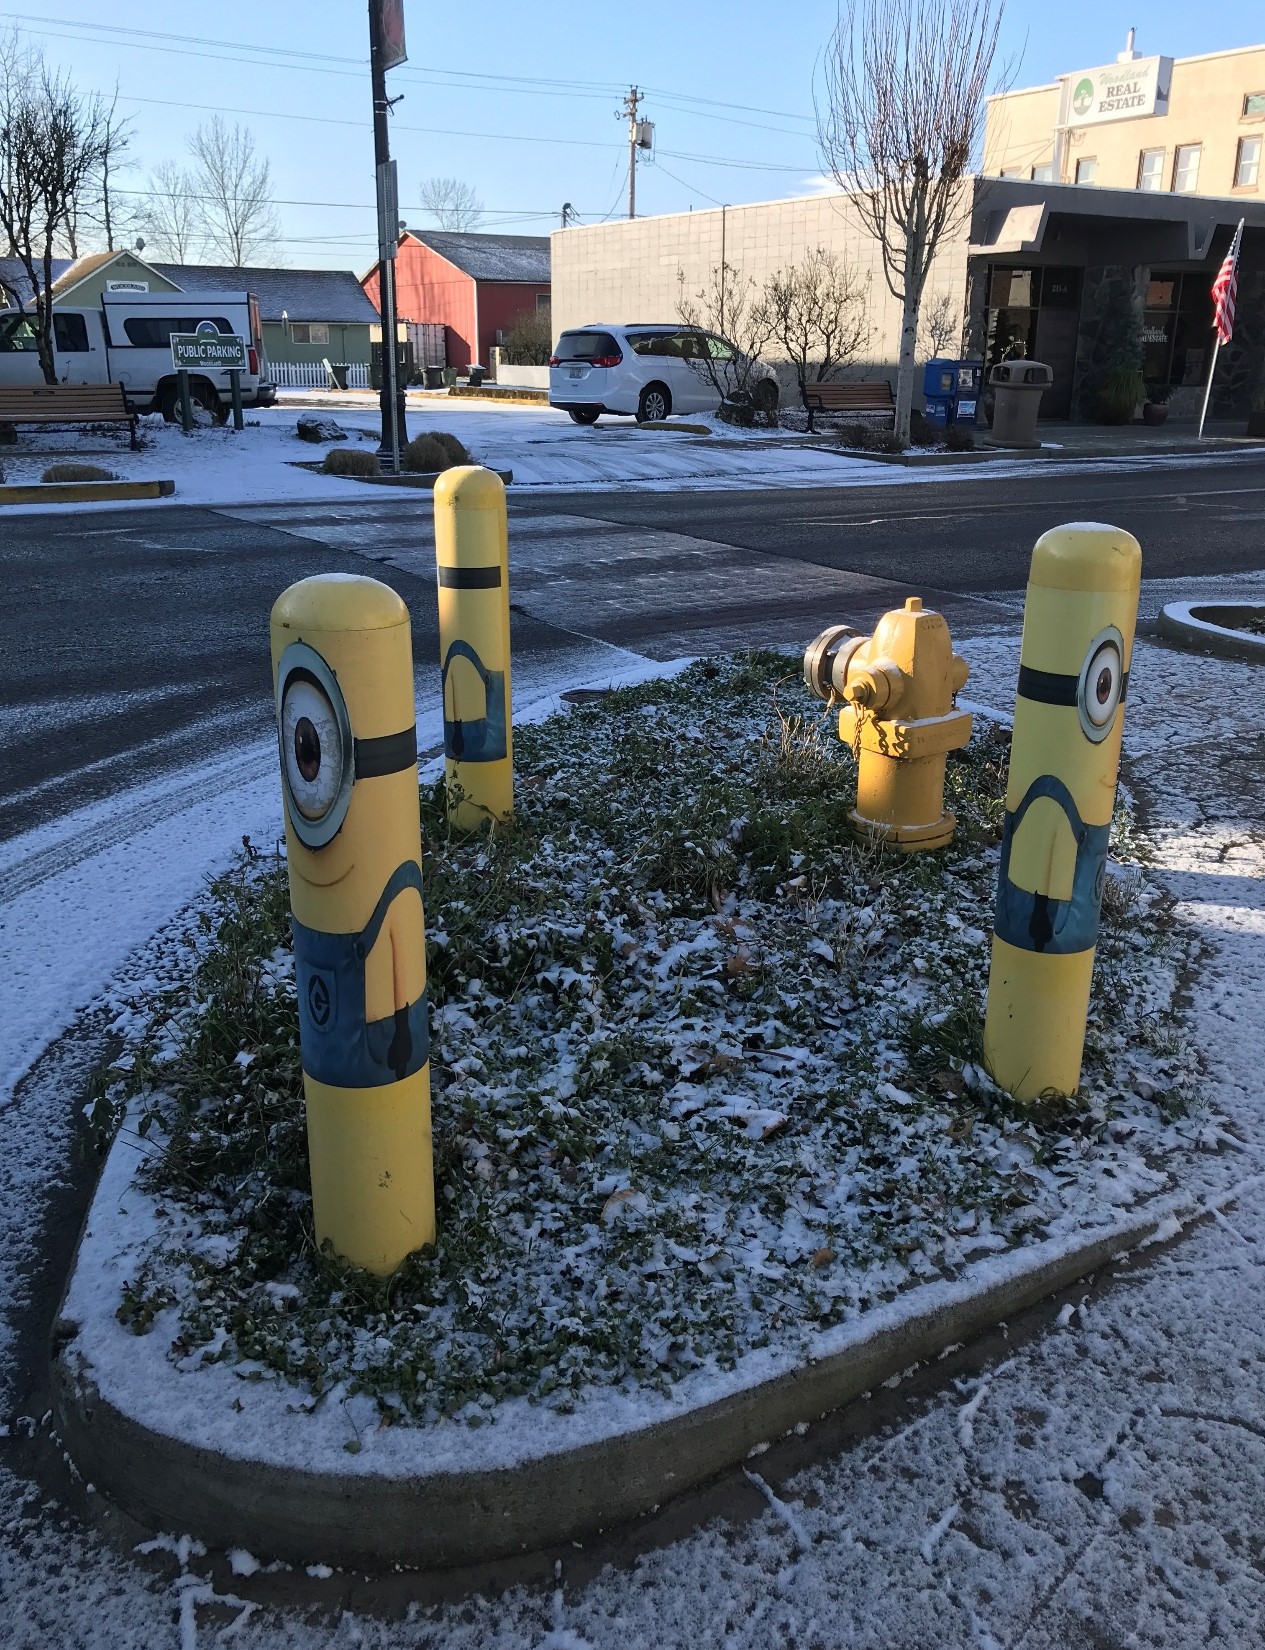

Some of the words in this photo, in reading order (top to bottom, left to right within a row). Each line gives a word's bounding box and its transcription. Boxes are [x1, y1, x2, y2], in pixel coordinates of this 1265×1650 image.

[1099, 65, 1150, 85] Woodland
[1106, 82, 1141, 98] REAL
[1098, 94, 1145, 112] ESTATE
[177, 346, 205, 357] PUBLIC
[207, 346, 241, 358] PARKING
